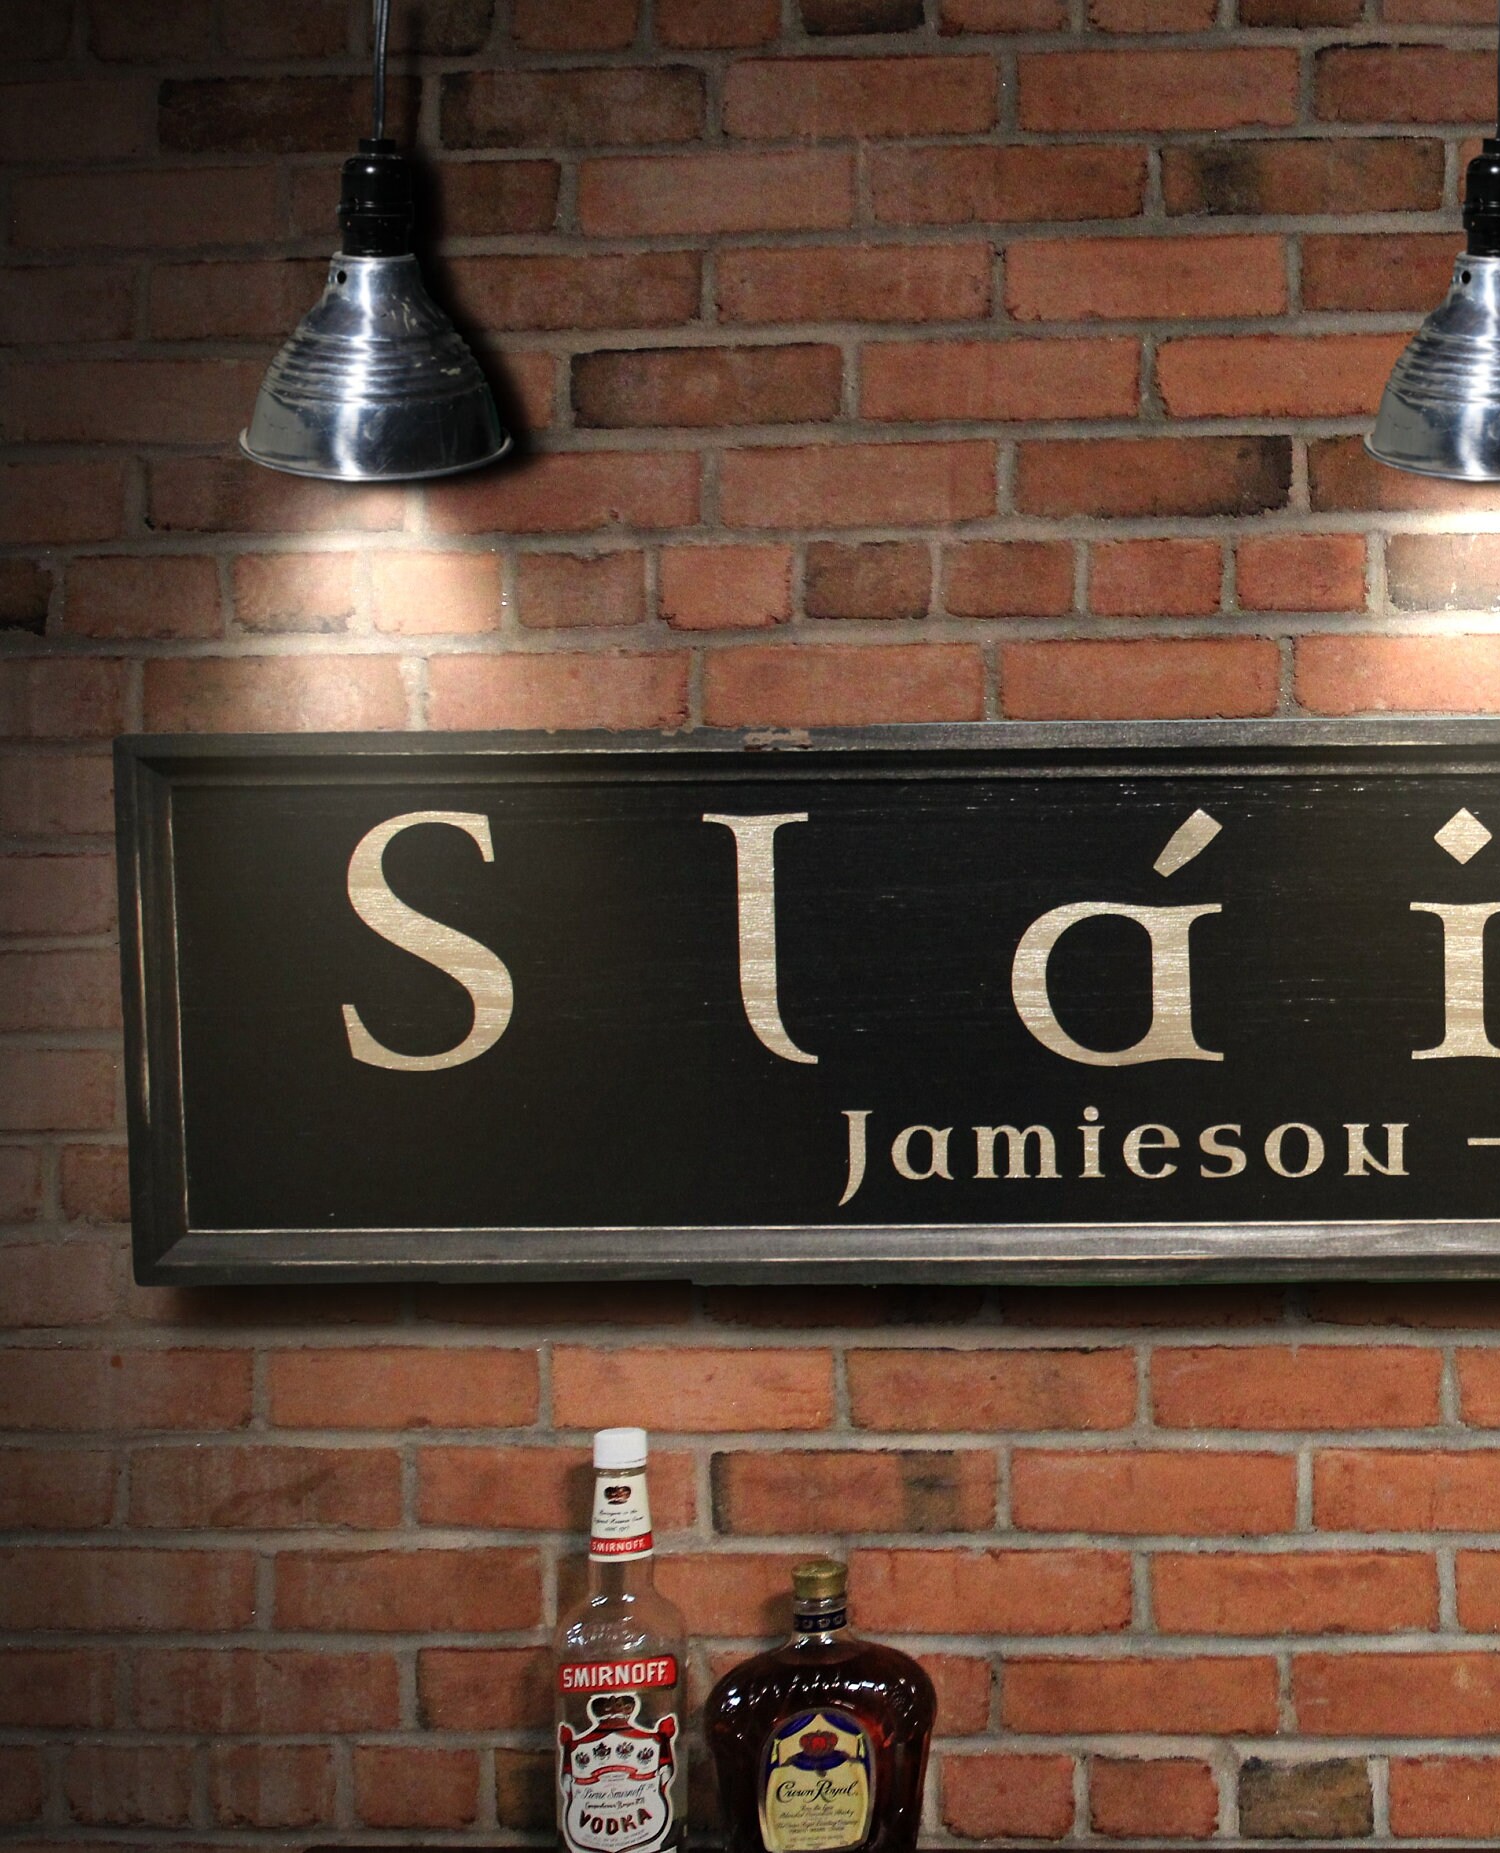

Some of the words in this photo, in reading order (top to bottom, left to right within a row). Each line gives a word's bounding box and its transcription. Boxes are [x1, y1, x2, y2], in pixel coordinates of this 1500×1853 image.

[838, 1107, 1410, 1207] Jamieson
[592, 1538, 644, 1552] SMIRNOFF
[562, 1661, 669, 1688] SMIRNOFF
[776, 1781, 814, 1803] Crown
[803, 1780, 859, 1803] Royal
[579, 1808, 652, 1836] VODKA
